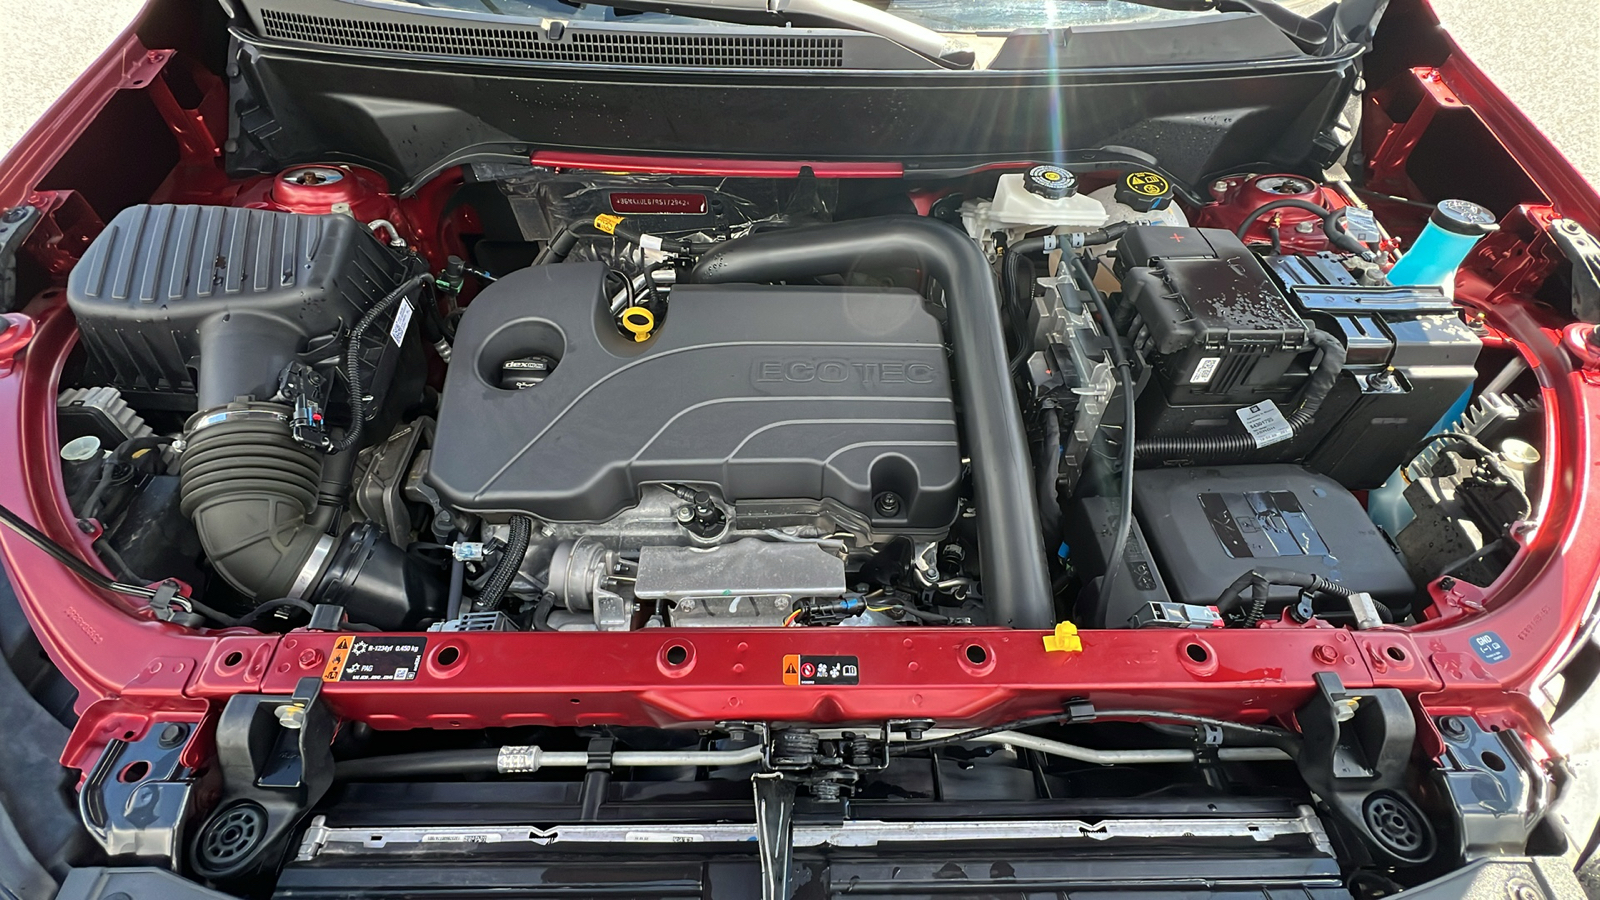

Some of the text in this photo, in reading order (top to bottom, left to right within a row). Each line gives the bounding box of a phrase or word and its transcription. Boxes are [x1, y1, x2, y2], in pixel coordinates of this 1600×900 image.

[505, 361, 544, 369] dexos
[756, 361, 935, 384] ECOTEC
[1475, 634, 1492, 646] GND
